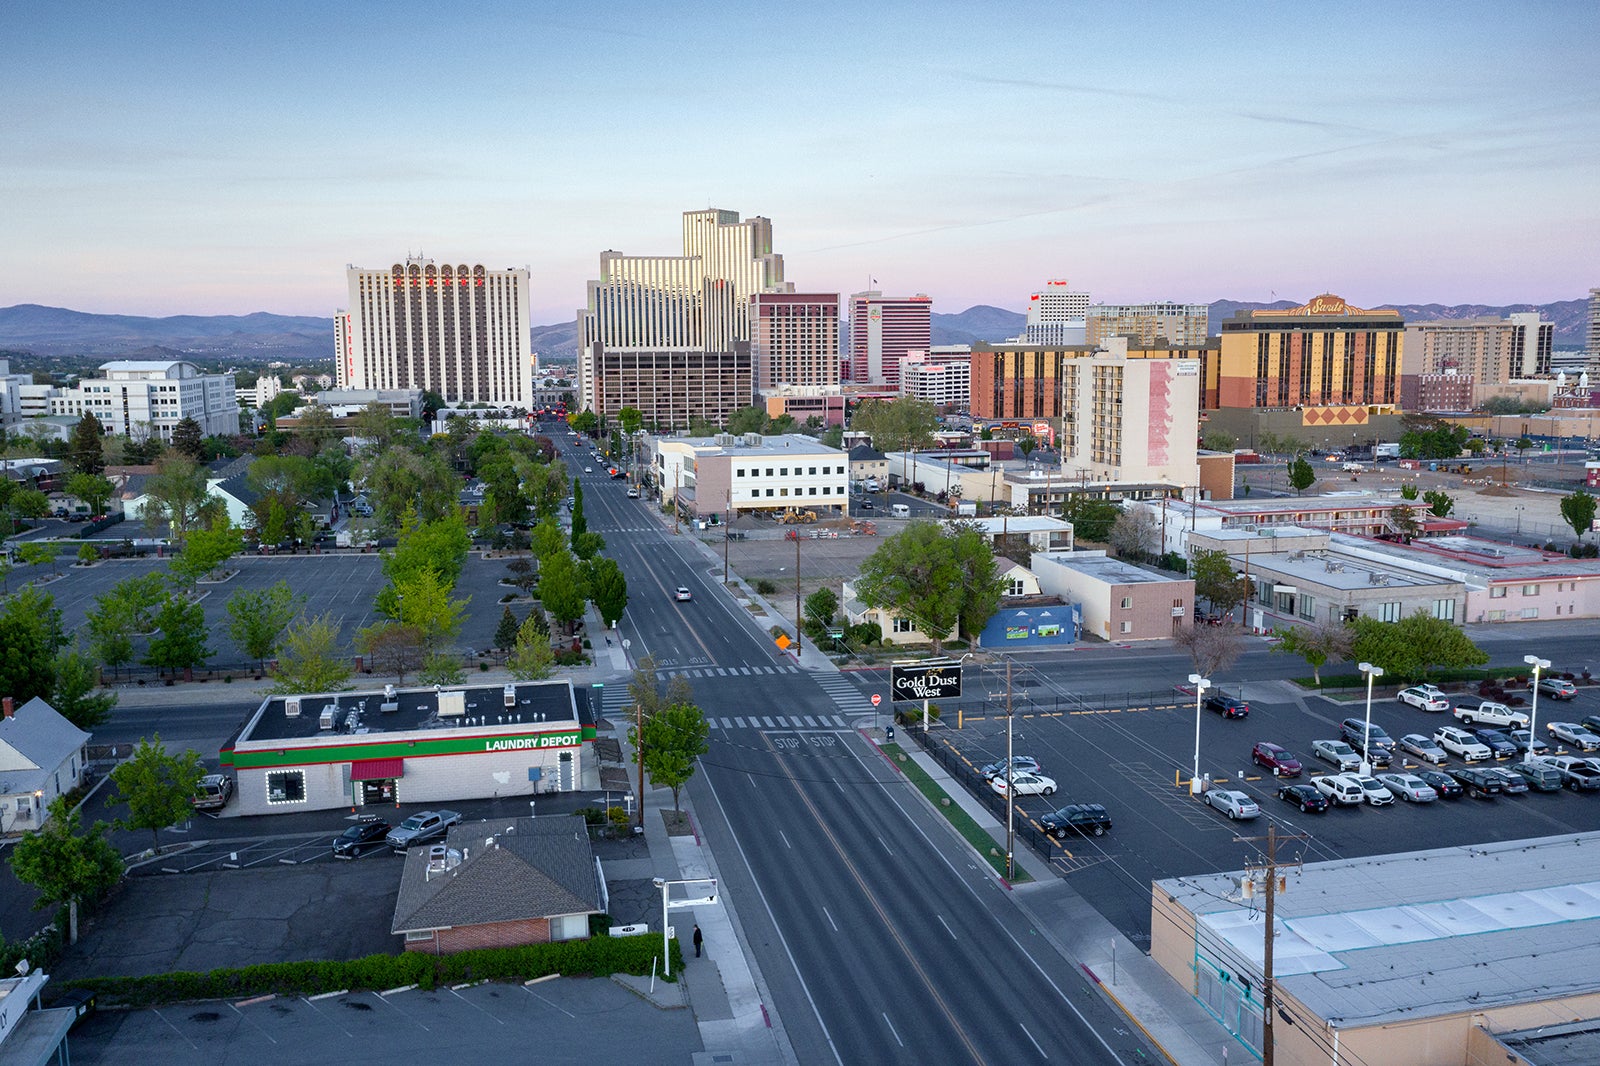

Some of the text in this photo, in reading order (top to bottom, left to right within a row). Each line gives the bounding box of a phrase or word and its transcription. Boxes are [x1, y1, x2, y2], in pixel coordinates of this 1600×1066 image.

[1312, 298, 1344, 313] Sands
[896, 675, 957, 689] Gold Dust
[913, 686, 941, 697] West
[485, 735, 577, 751] LAUNDRY DEPOT
[774, 737, 800, 749] STOP
[810, 736, 836, 747] STOP
